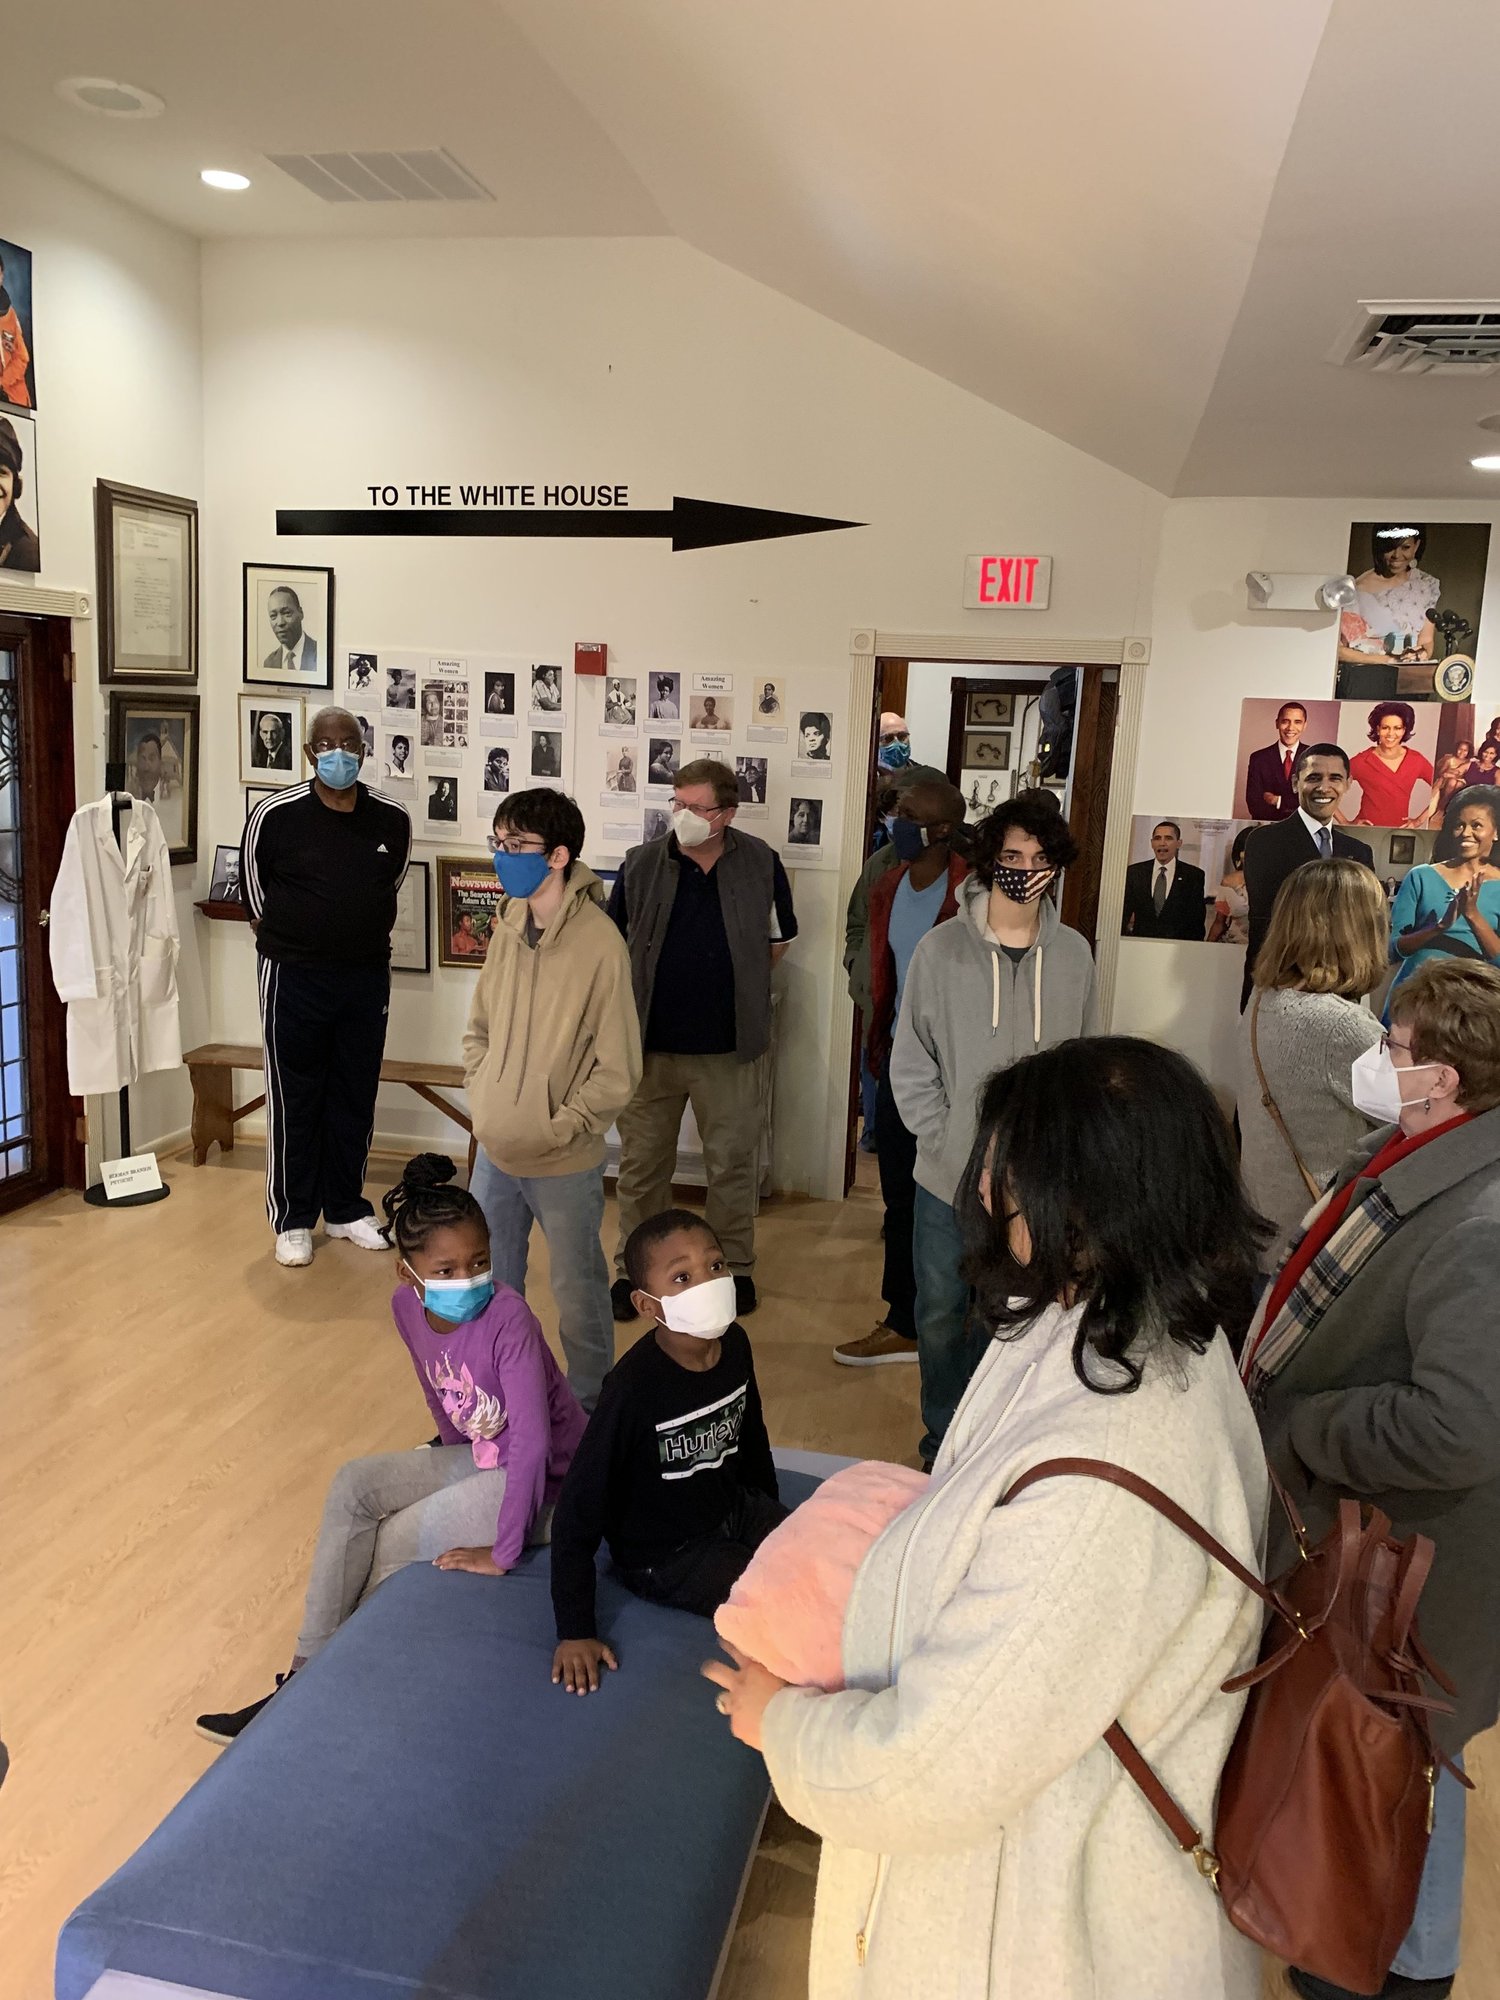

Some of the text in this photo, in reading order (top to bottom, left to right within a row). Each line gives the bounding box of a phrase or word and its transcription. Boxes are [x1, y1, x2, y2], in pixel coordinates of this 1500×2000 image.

[368, 486, 629, 506] TO THE WHITE HOUSE
[978, 556, 1040, 604] EXIT
[451, 876, 503, 889] Newswee
[457, 890, 468, 898] The
[470, 890, 491, 899] Search
[462, 897, 479, 905] Adam
[487, 898, 497, 906] Eve
[665, 1414, 739, 1462] Hurley
